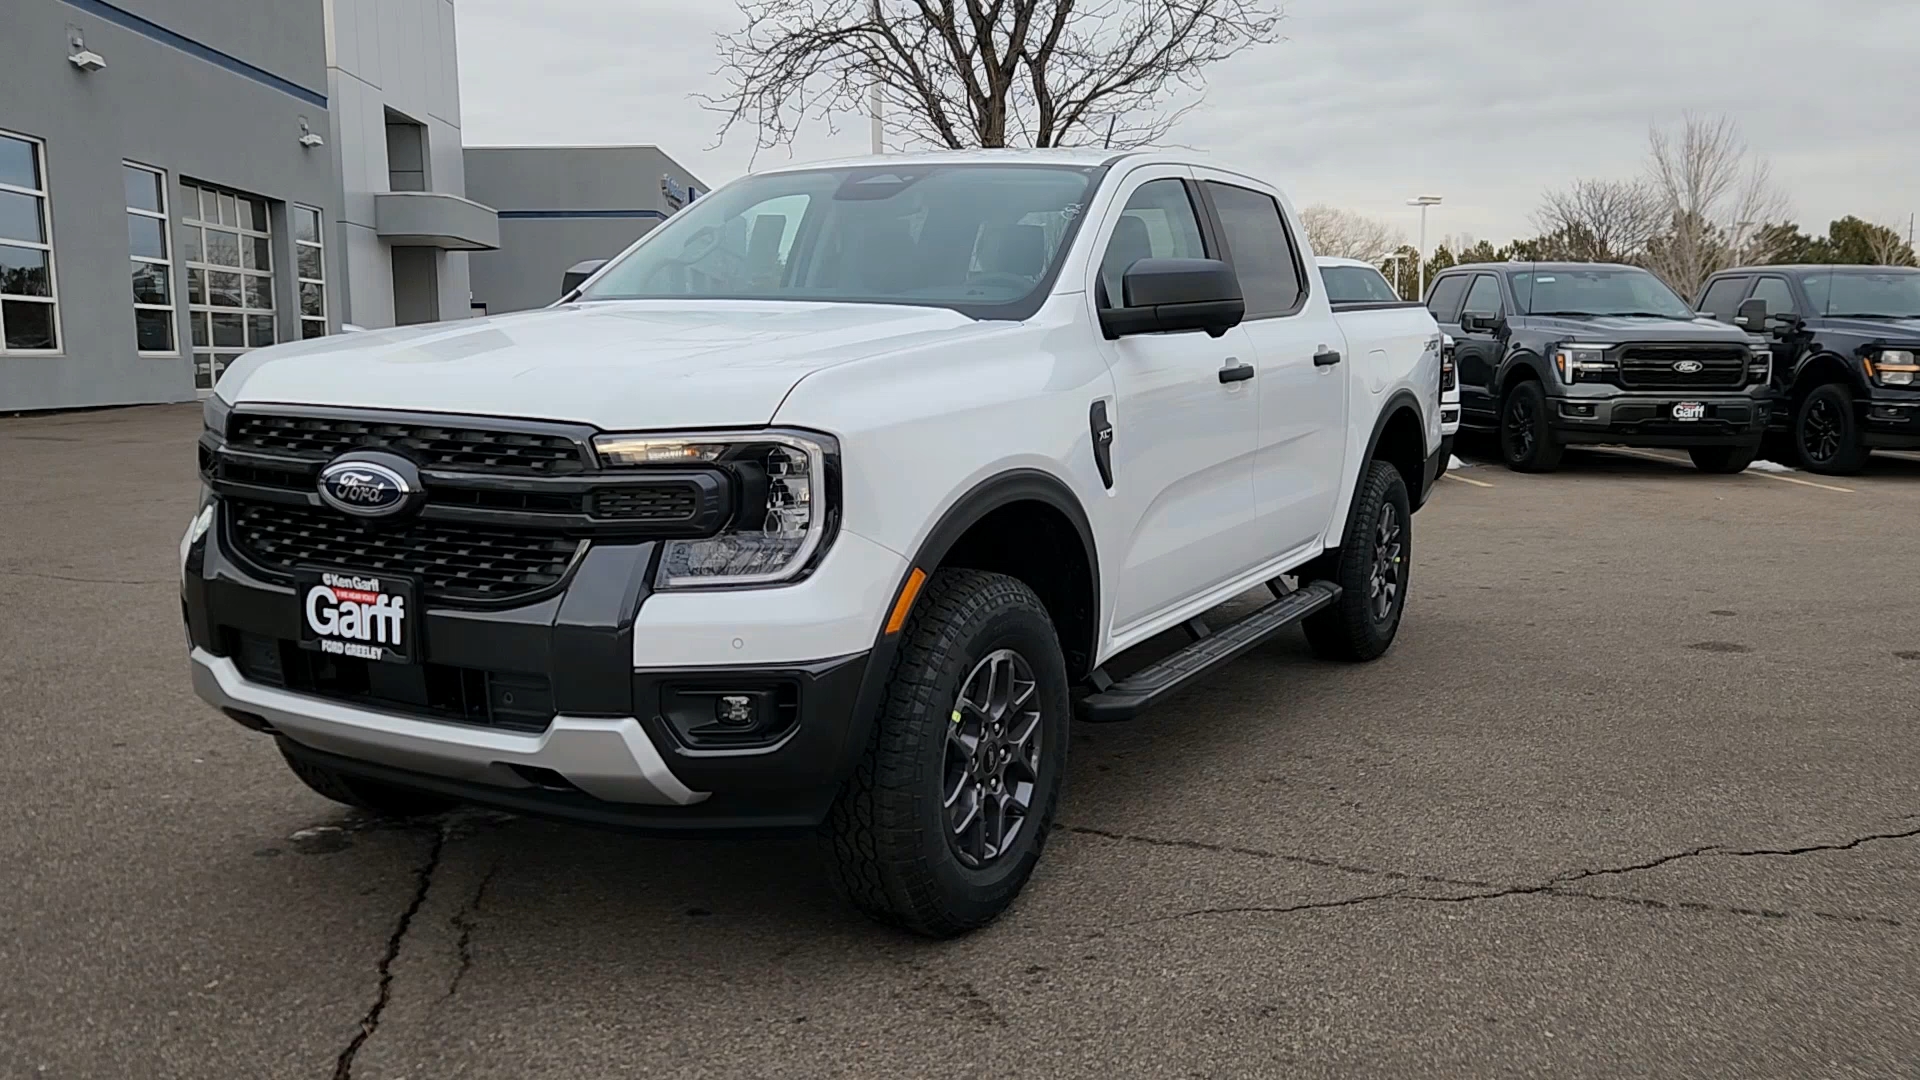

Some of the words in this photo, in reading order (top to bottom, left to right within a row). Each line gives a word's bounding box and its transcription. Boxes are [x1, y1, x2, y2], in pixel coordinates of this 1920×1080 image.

[1673, 404, 1705, 418] Garff
[1099, 428, 1112, 441] XLT
[336, 472, 384, 502] Ford
[331, 574, 353, 588] Ken
[353, 577, 379, 592] Garff
[306, 586, 405, 645] Garff
[321, 640, 344, 655] FORD
